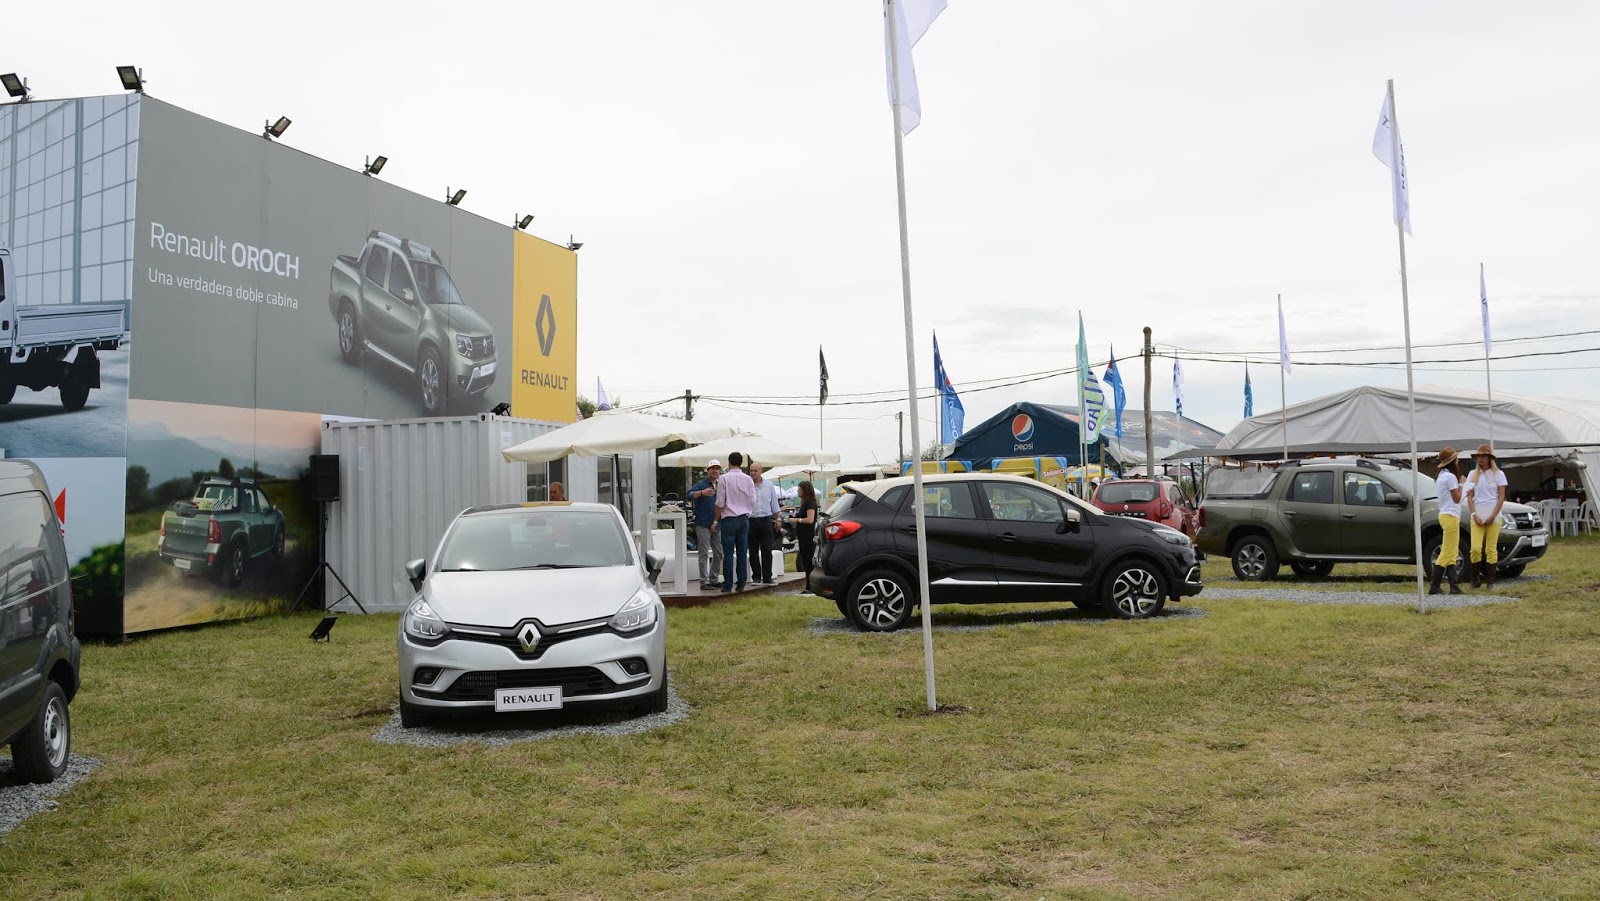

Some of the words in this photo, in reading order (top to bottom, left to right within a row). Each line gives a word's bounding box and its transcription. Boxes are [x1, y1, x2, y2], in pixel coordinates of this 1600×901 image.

[150, 222, 226, 264] Renault
[231, 242, 299, 279] OROCH
[148, 267, 173, 286] Una
[176, 276, 233, 297] verdadera
[236, 285, 264, 303] doble
[266, 292, 298, 309] cabina
[521, 369, 568, 391] RENAULT
[1013, 442, 1034, 452] pepsi
[503, 693, 555, 704] RENAULT
